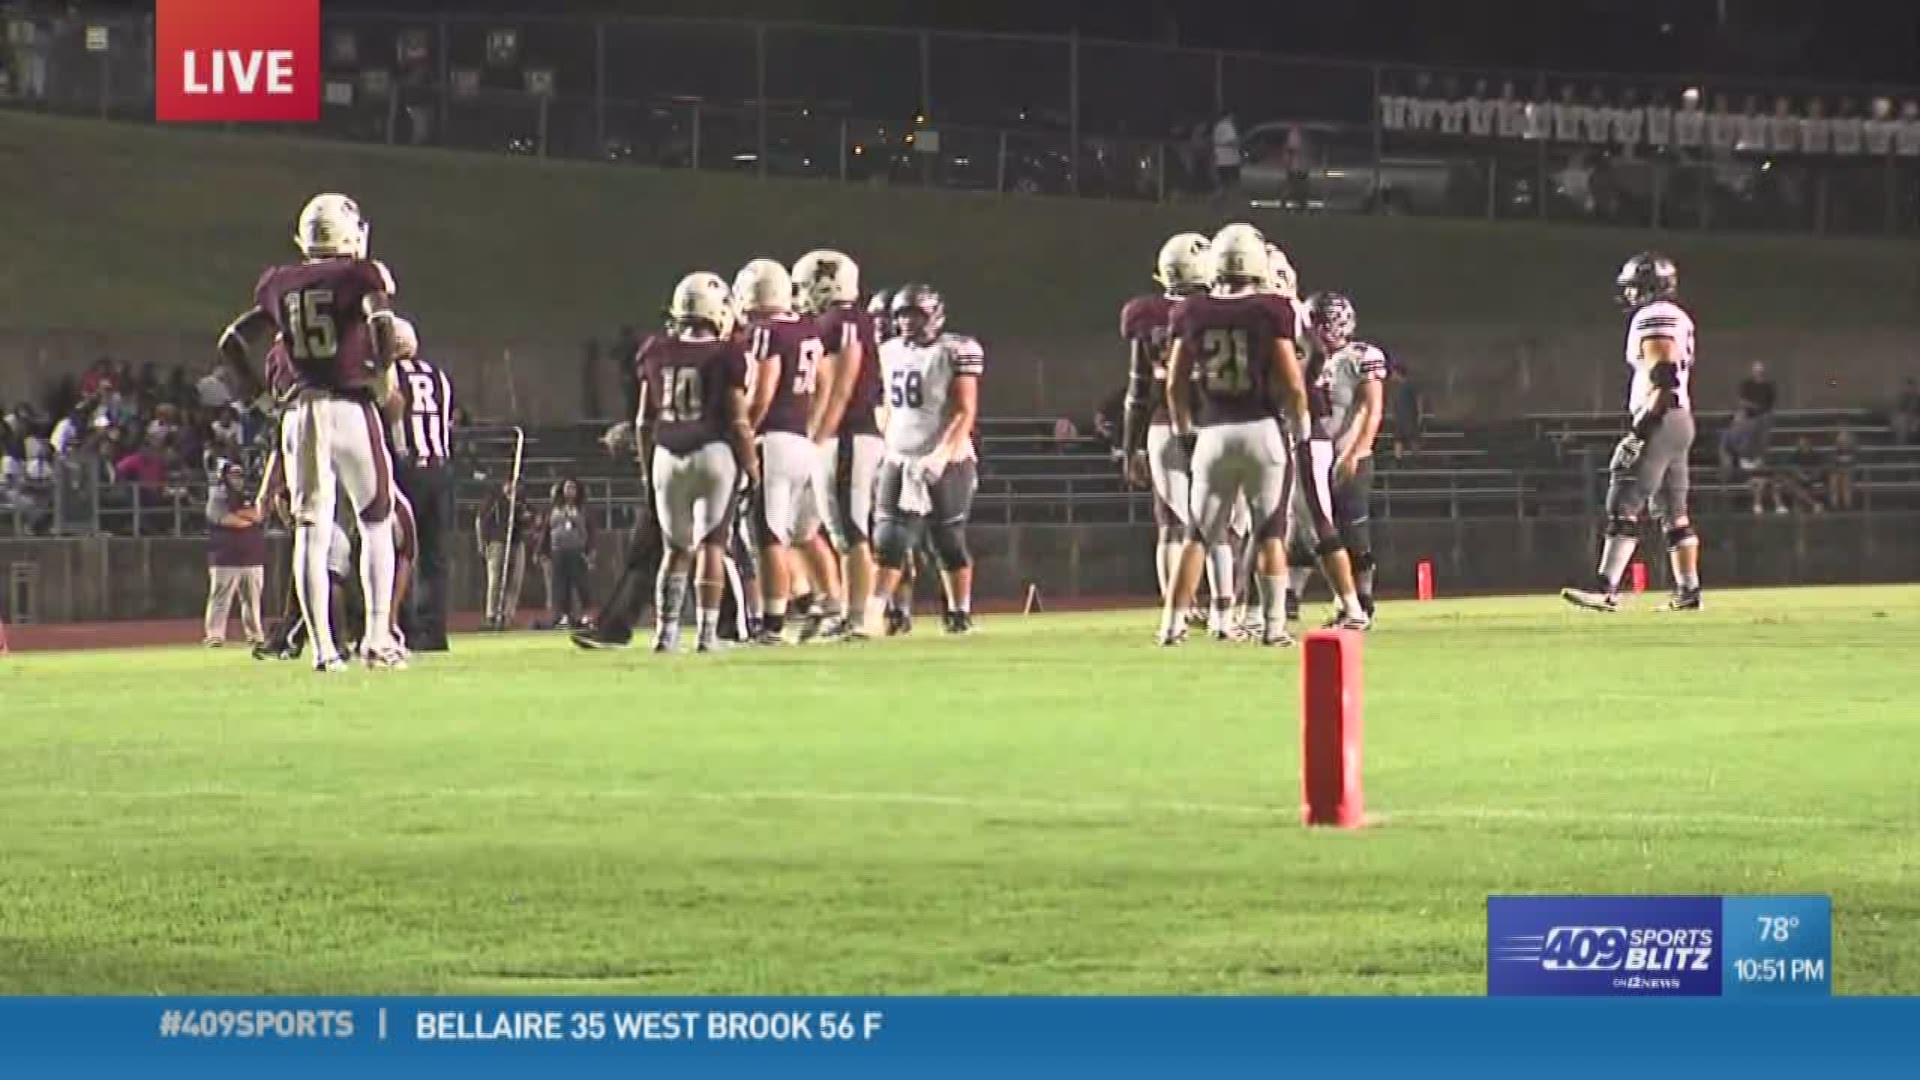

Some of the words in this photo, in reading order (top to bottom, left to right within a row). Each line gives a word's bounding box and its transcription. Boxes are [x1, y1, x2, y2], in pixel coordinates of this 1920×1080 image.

[284, 289, 337, 358] 15
[1203, 327, 1250, 390] 21
[408, 374, 438, 412] R
[659, 367, 701, 422] 10
[891, 370, 924, 408] 58
